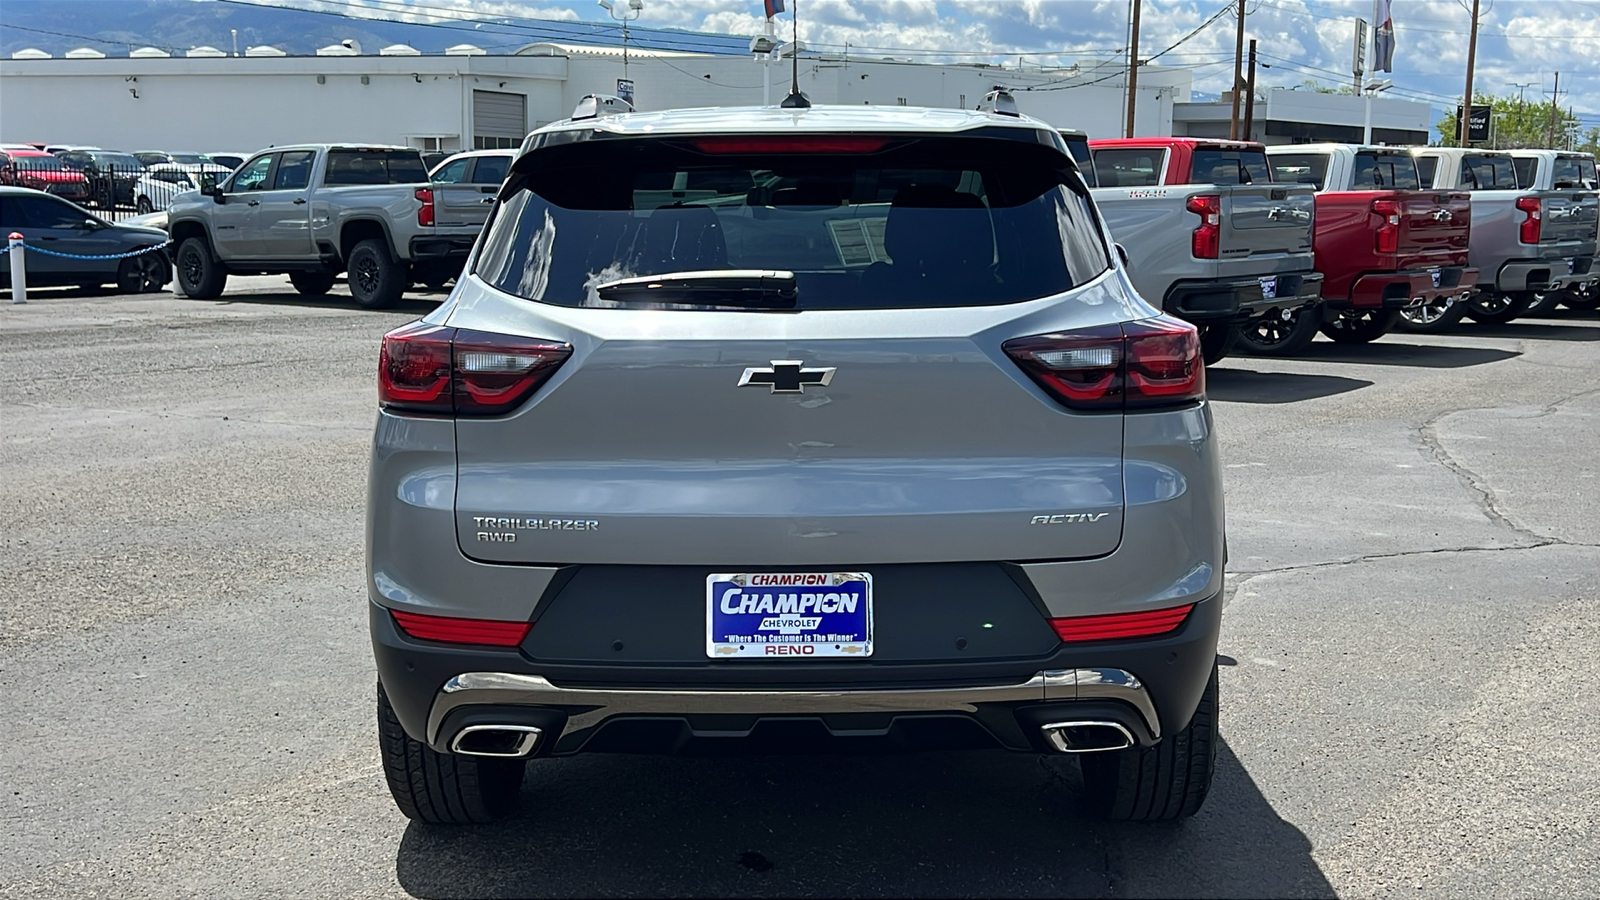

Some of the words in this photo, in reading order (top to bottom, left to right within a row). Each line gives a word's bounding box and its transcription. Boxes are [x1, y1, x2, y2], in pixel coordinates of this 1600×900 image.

[473, 517, 599, 531] TRAILBLAZER
[1030, 512, 1109, 525] ACTIV
[477, 532, 516, 543] AWD
[752, 574, 828, 586] CHAMPION
[720, 588, 859, 615] CHAMPION
[762, 619, 817, 628] CHEVROLET
[753, 634, 767, 642] The
[768, 634, 803, 642] Customer
[813, 634, 825, 642] The
[765, 645, 815, 655] RENO
